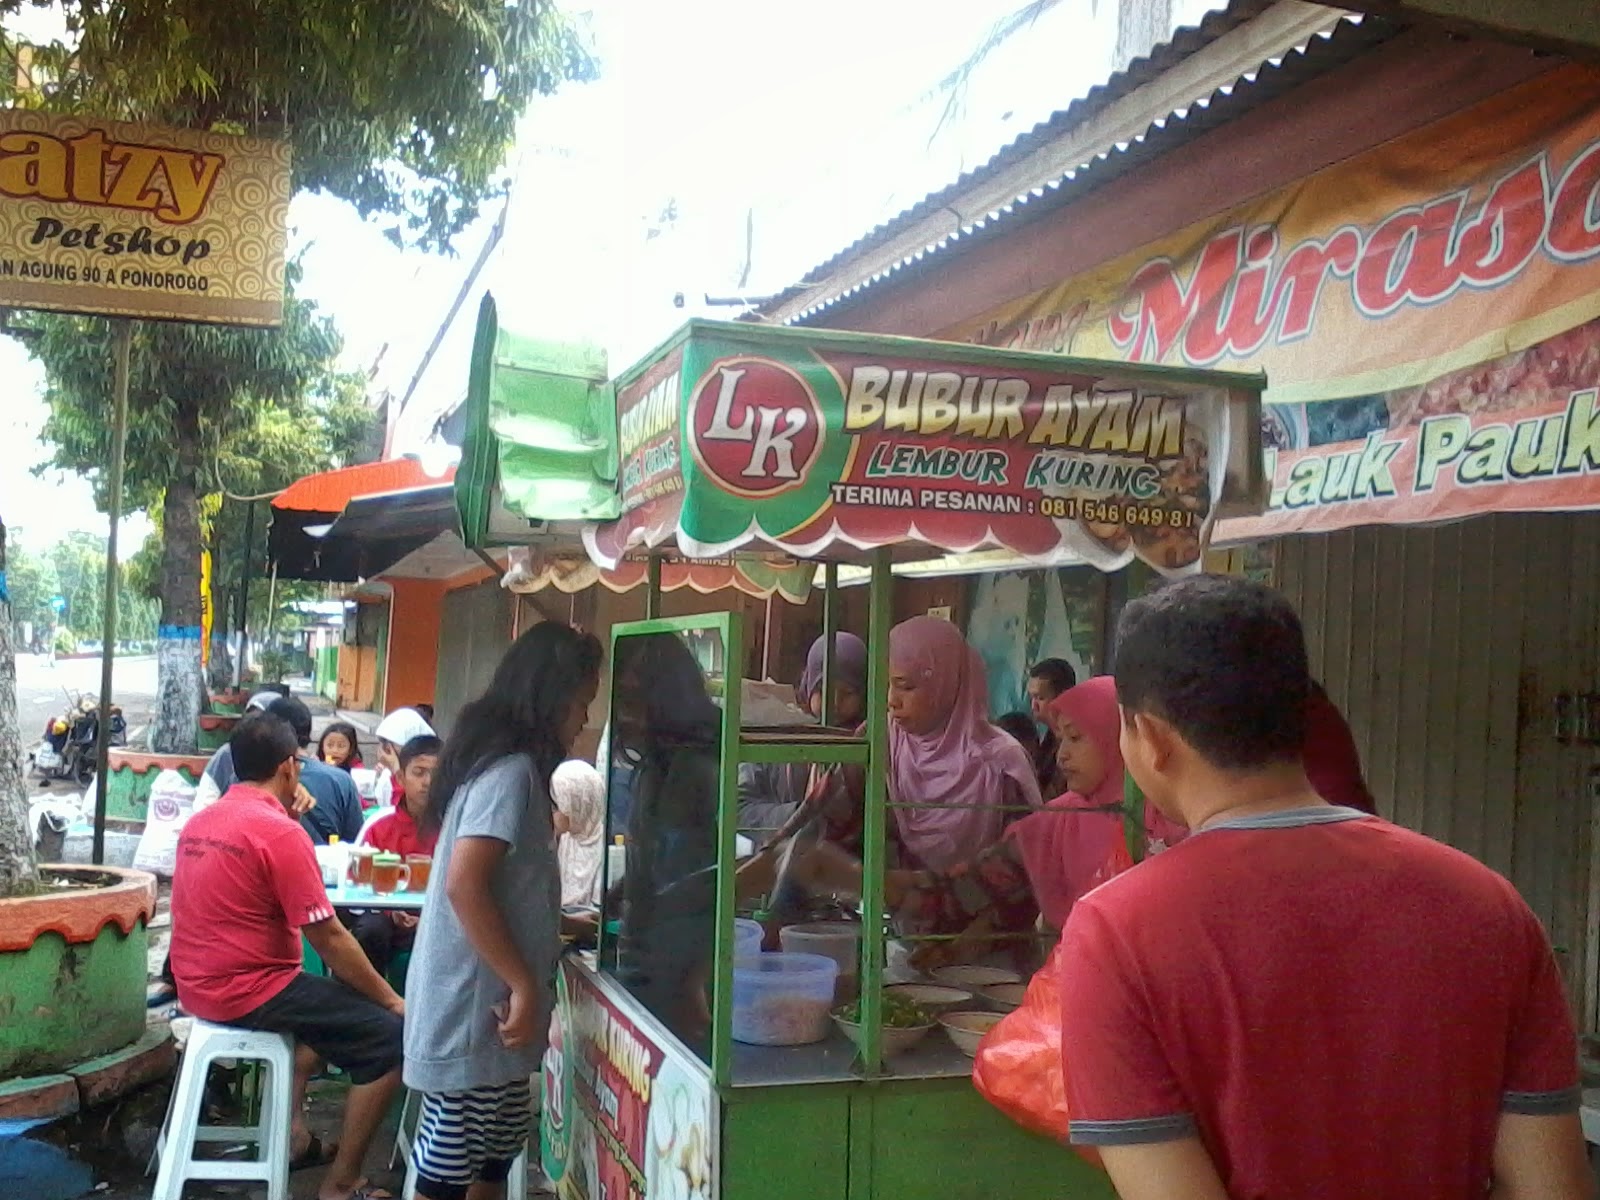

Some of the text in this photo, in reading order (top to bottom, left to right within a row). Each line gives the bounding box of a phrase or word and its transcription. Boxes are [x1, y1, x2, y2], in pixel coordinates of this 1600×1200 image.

[31, 217, 211, 265] Petshop
[19, 262, 77, 281] AGUNG
[82, 267, 100, 283] 90
[105, 268, 116, 284] A
[121, 269, 209, 291] PONOROGO
[844, 366, 1187, 457] BUBUR AYAM
[865, 440, 1162, 499] LEMBUR KURING
[831, 484, 912, 507] TERIMA
[919, 488, 1022, 514] PESANAN
[1041, 498, 1076, 518] 081
[1084, 502, 1120, 524] 546
